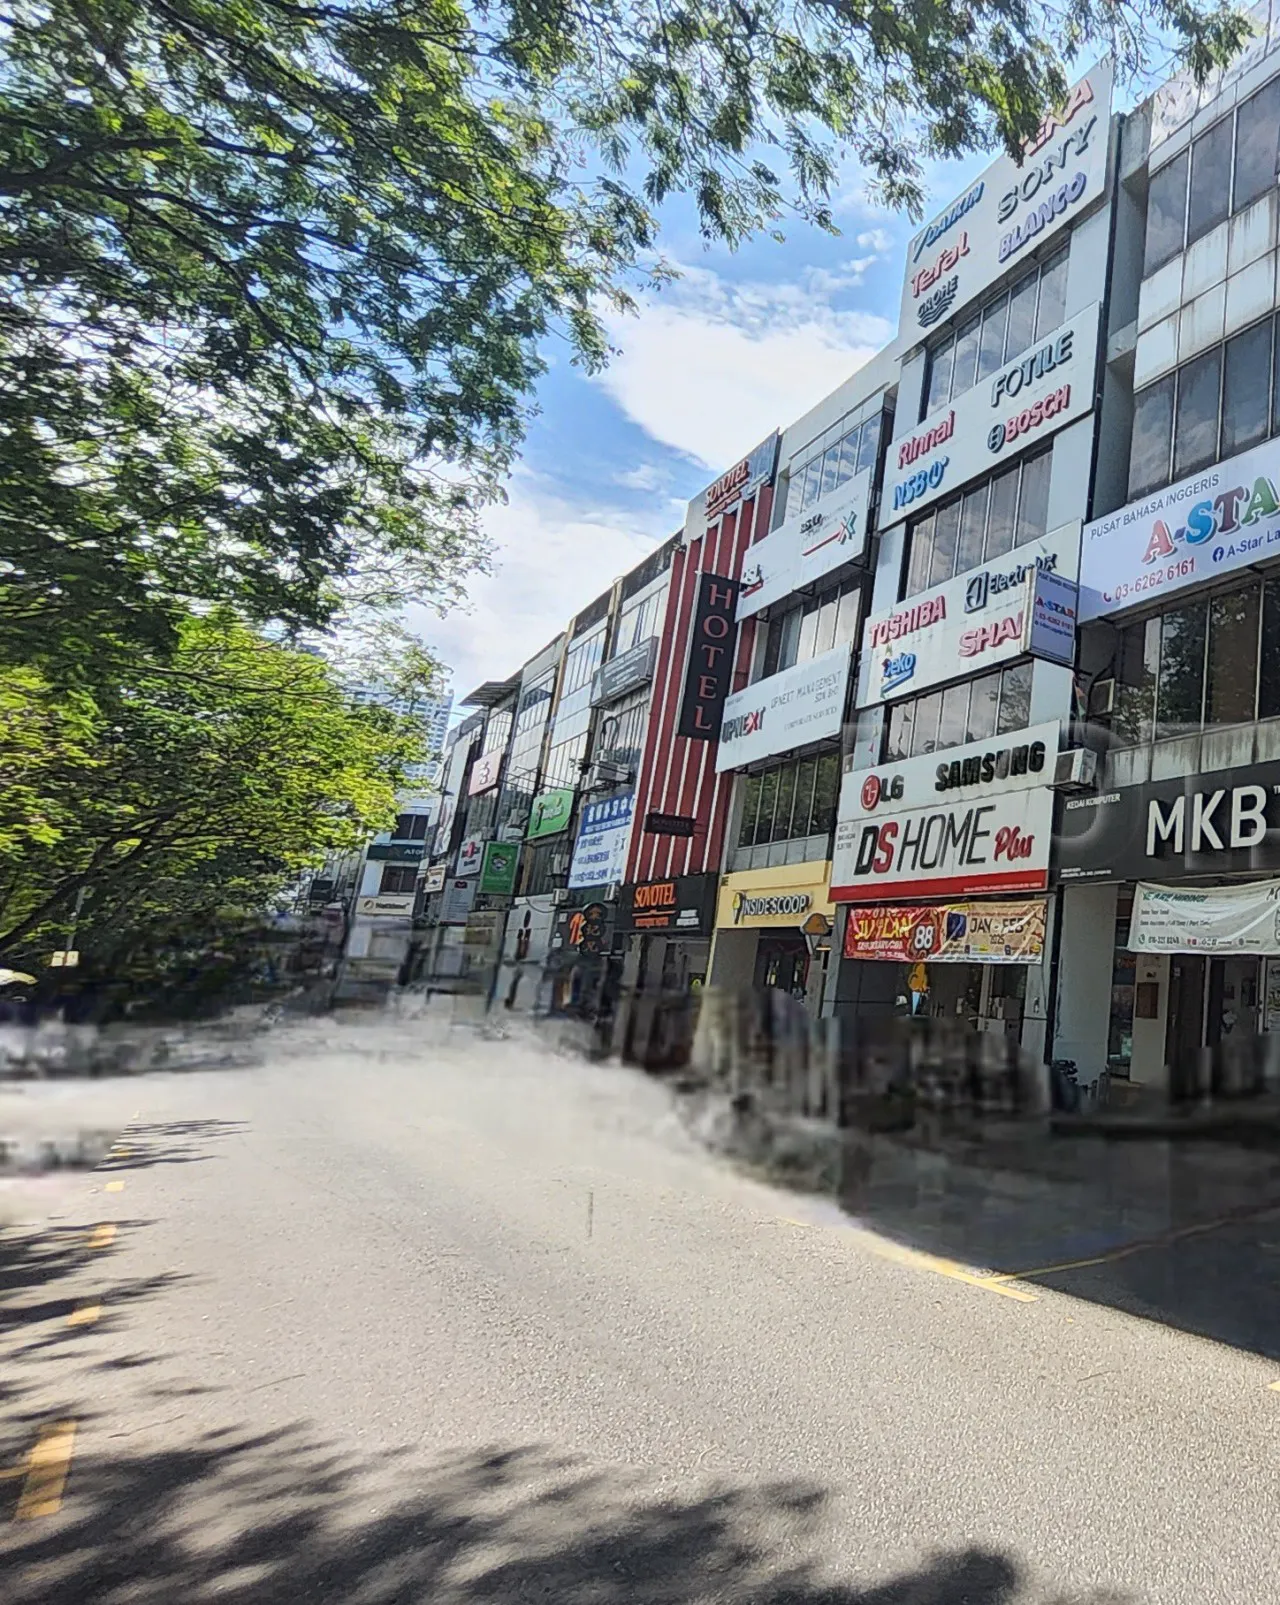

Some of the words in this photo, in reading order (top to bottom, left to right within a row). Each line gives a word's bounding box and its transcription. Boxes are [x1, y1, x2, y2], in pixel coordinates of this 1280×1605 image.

[998, 114, 1098, 224] SONY
[926, 181, 985, 249] DAIKIN
[999, 171, 1087, 264] BLANCO
[910, 231, 970, 299] Tefal
[990, 329, 1075, 408] FOTILE
[898, 409, 956, 470] Rinnai
[1003, 383, 1072, 444] BOSCH
[1090, 514, 1120, 541] PUSAT
[1123, 496, 1164, 526] BAHASA
[1165, 473, 1220, 510] INGGERIS
[1226, 534, 1262, 559] A-Star
[1115, 569, 1164, 601] 03-6262
[1167, 557, 1196, 583] 6161
[869, 595, 947, 649] TOSHIBA
[694, 583, 732, 731] HOTEL
[880, 773, 905, 803] LG
[935, 741, 1047, 792] SAMSUNG
[1066, 799, 1085, 811] KEDAI
[1146, 785, 1268, 857] MKB
[994, 826, 1035, 863] Plus
[770, 894, 807, 915] SCOOP
[914, 925, 934, 949] 88
